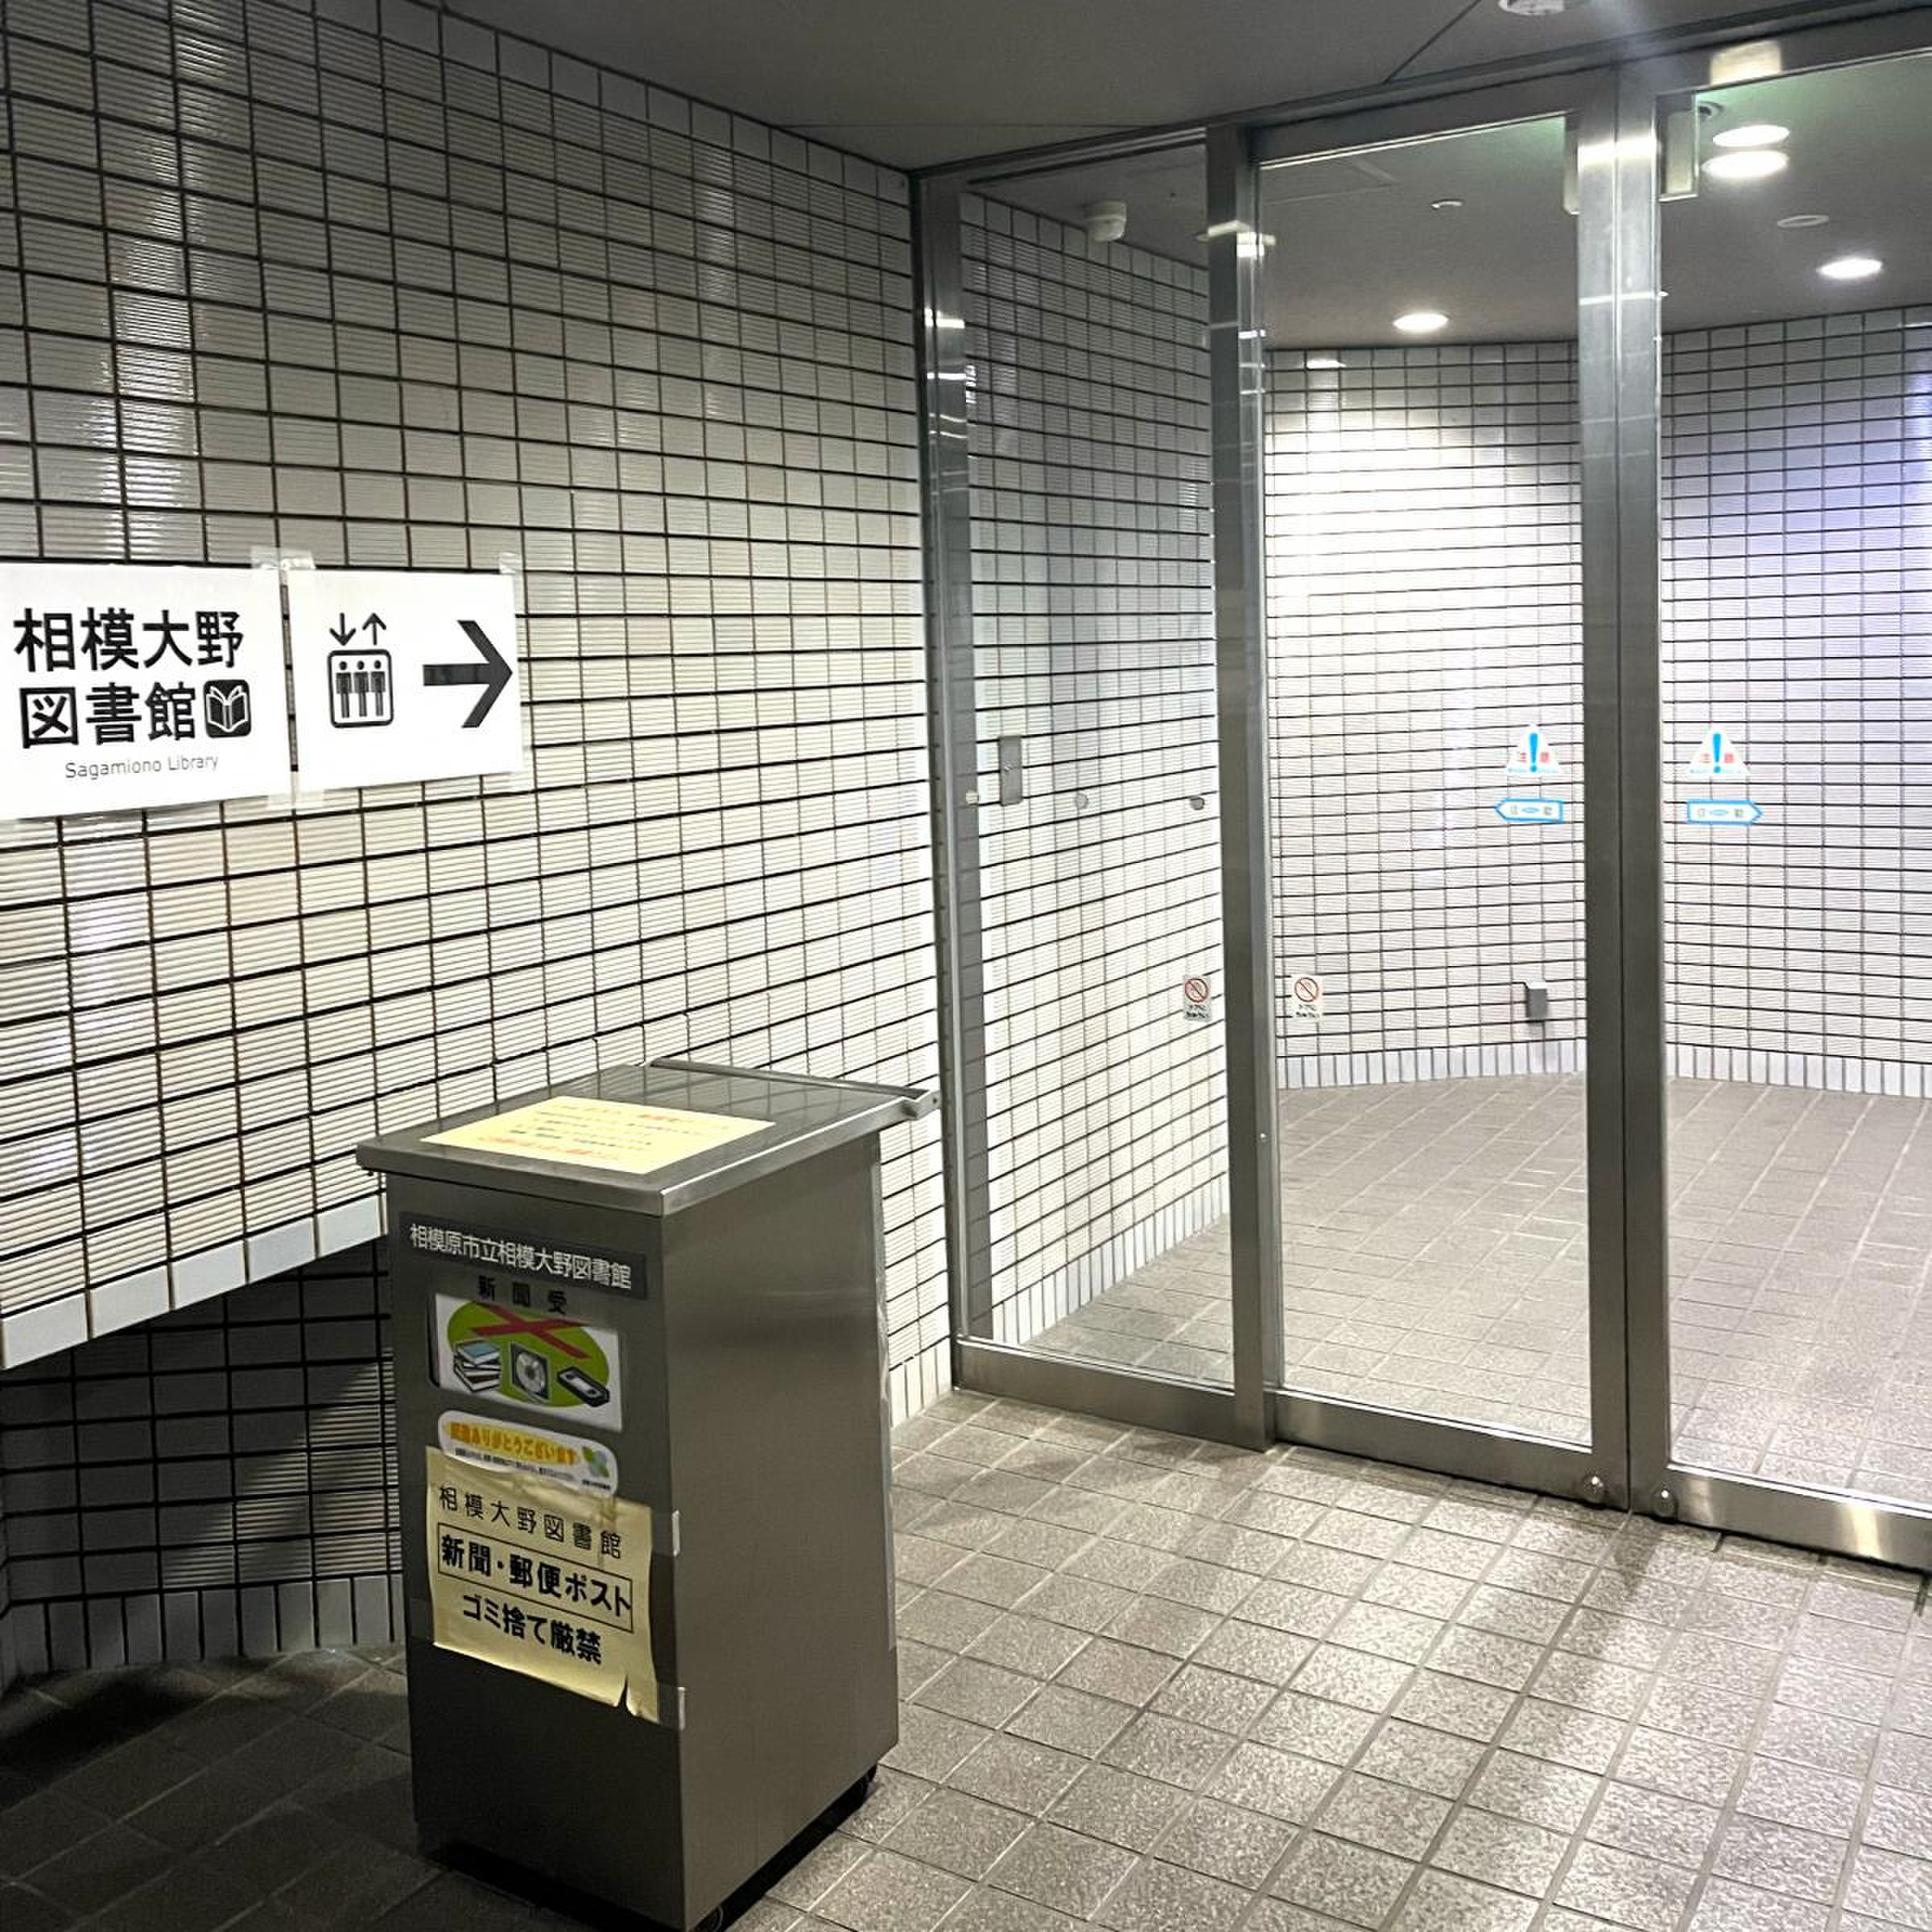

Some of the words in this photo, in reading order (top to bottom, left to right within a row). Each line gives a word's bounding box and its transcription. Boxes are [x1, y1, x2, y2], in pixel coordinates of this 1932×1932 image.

[14, 607, 243, 672] 相模大野
[20, 682, 196, 748] 図書館
[64, 761, 162, 779] Sagamiono
[167, 754, 219, 772] Library
[410, 1223, 632, 1290] 相模原市立相模大野図書館
[439, 1486, 621, 1559] 相模大野図書館
[441, 1534, 632, 1617] 新聞・郵便ポスト
[462, 1593, 602, 1665] ゴミ捨て厳禁
